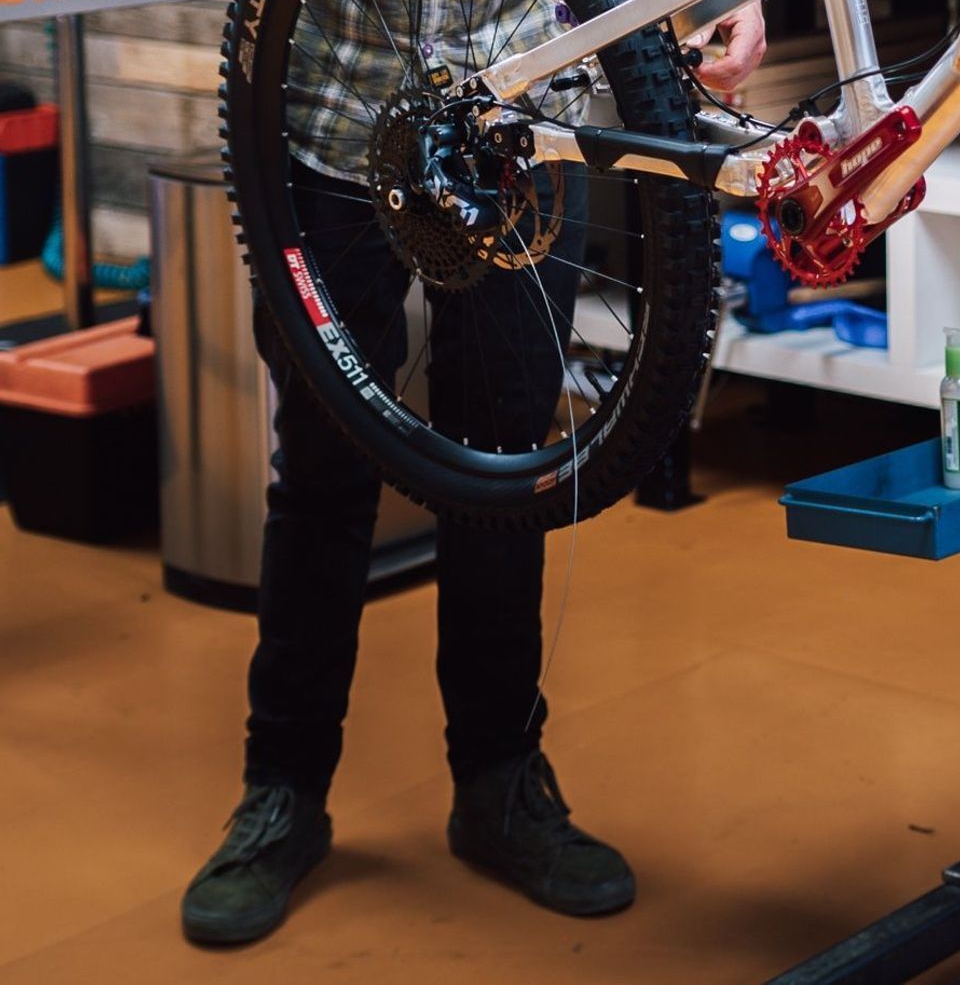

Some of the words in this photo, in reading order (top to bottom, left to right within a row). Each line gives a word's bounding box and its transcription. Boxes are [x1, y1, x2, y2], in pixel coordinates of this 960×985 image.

[286, 253, 301, 270] DT
[292, 271, 311, 300] SWISS
[316, 321, 369, 386] EX511
